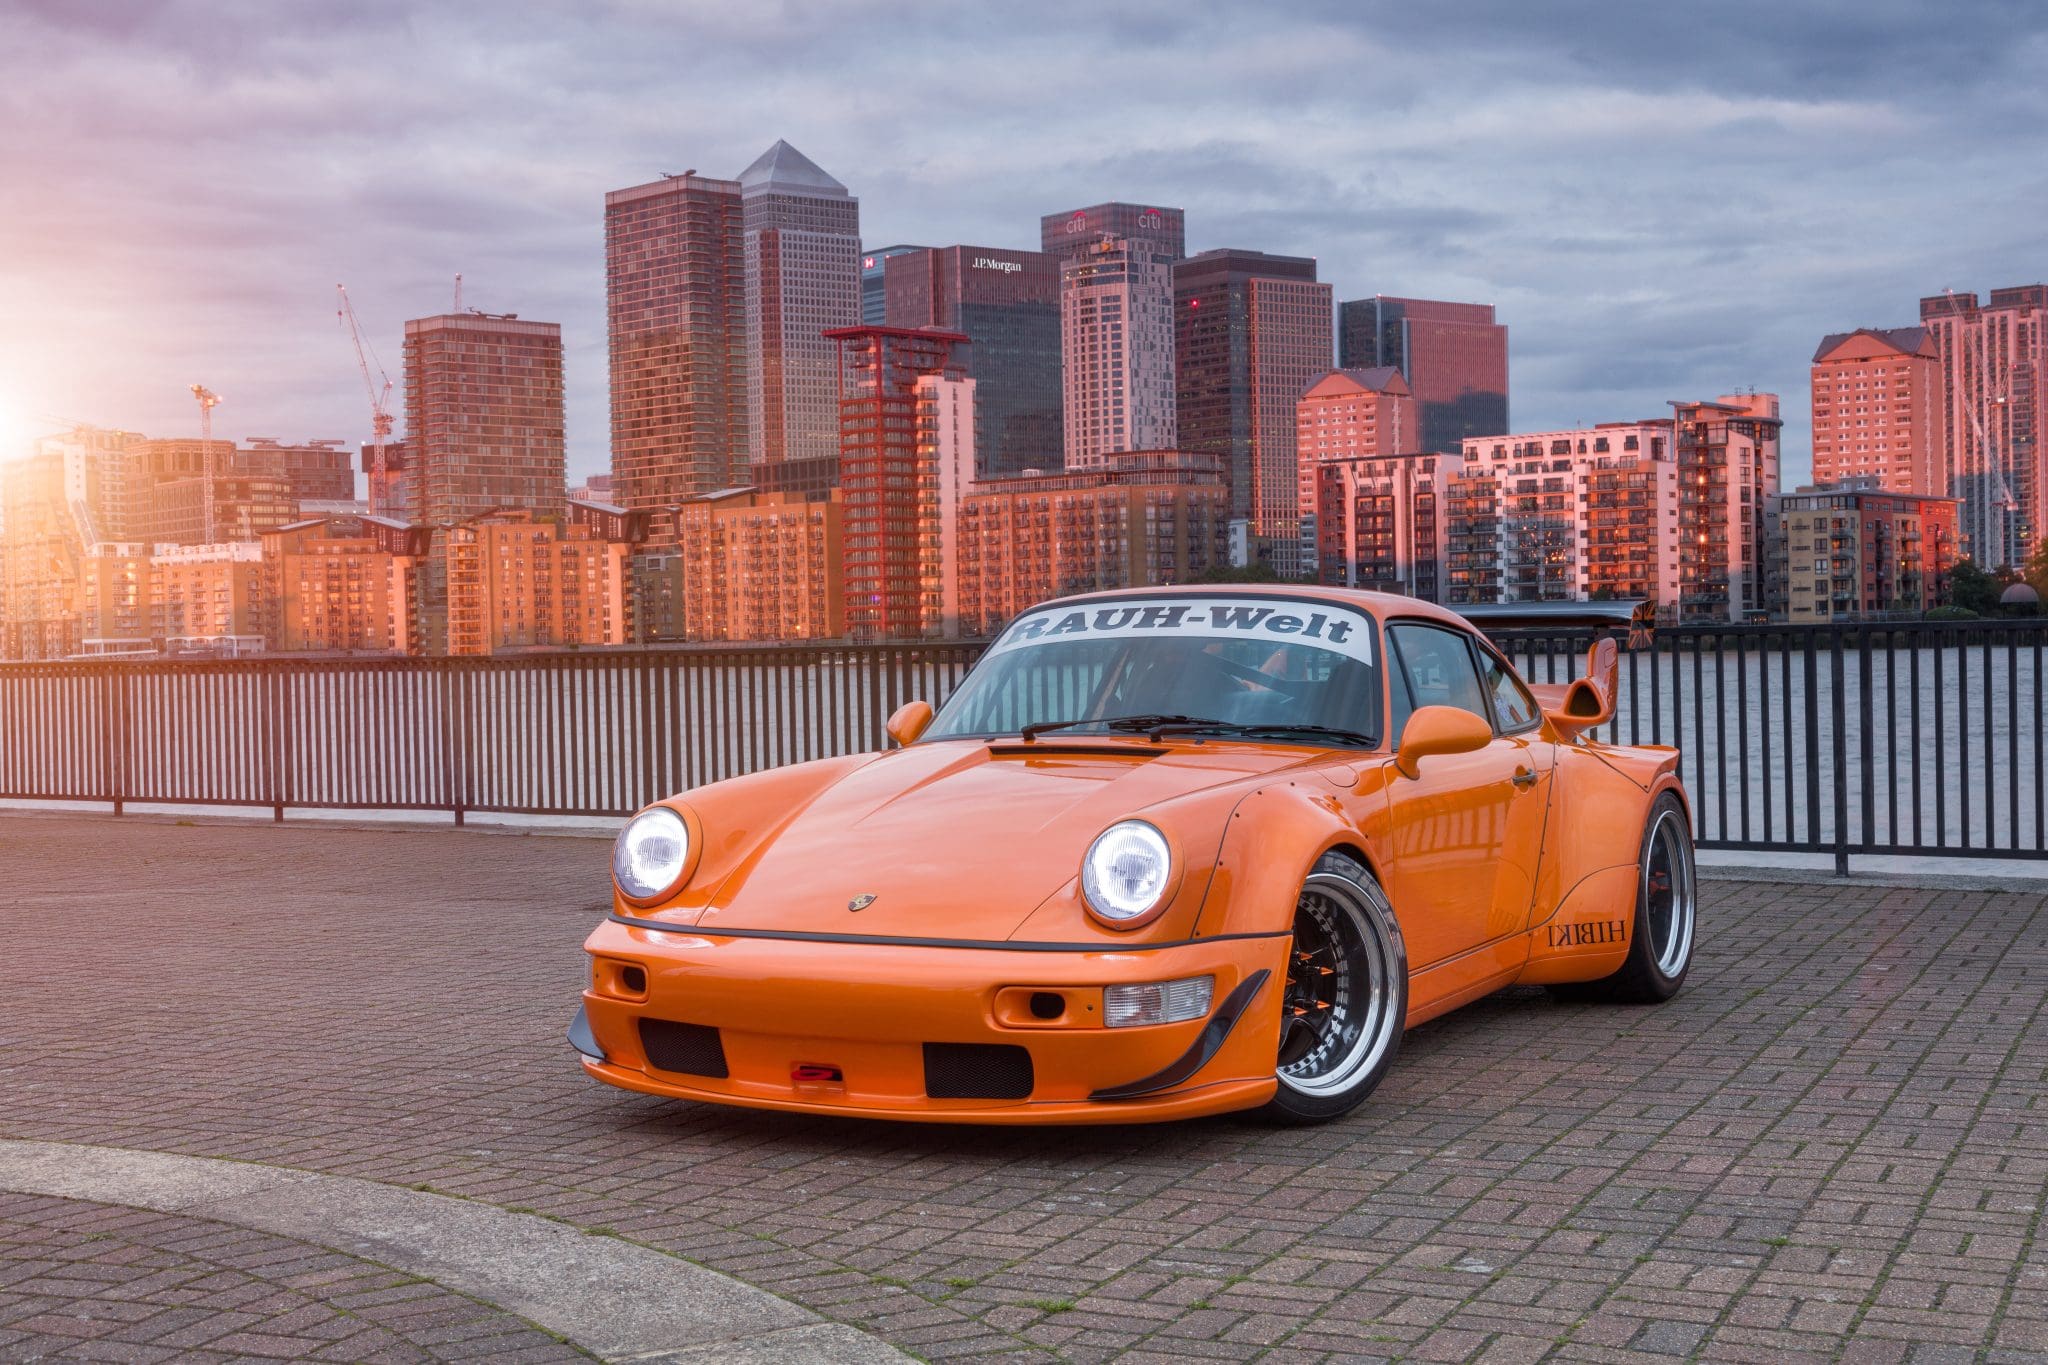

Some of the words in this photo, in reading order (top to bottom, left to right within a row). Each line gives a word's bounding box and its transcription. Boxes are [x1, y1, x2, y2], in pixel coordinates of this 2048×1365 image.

[1066, 216, 1086, 234] citi
[1138, 213, 1161, 230] citi
[1002, 605, 1353, 646] RAUH-Welt
